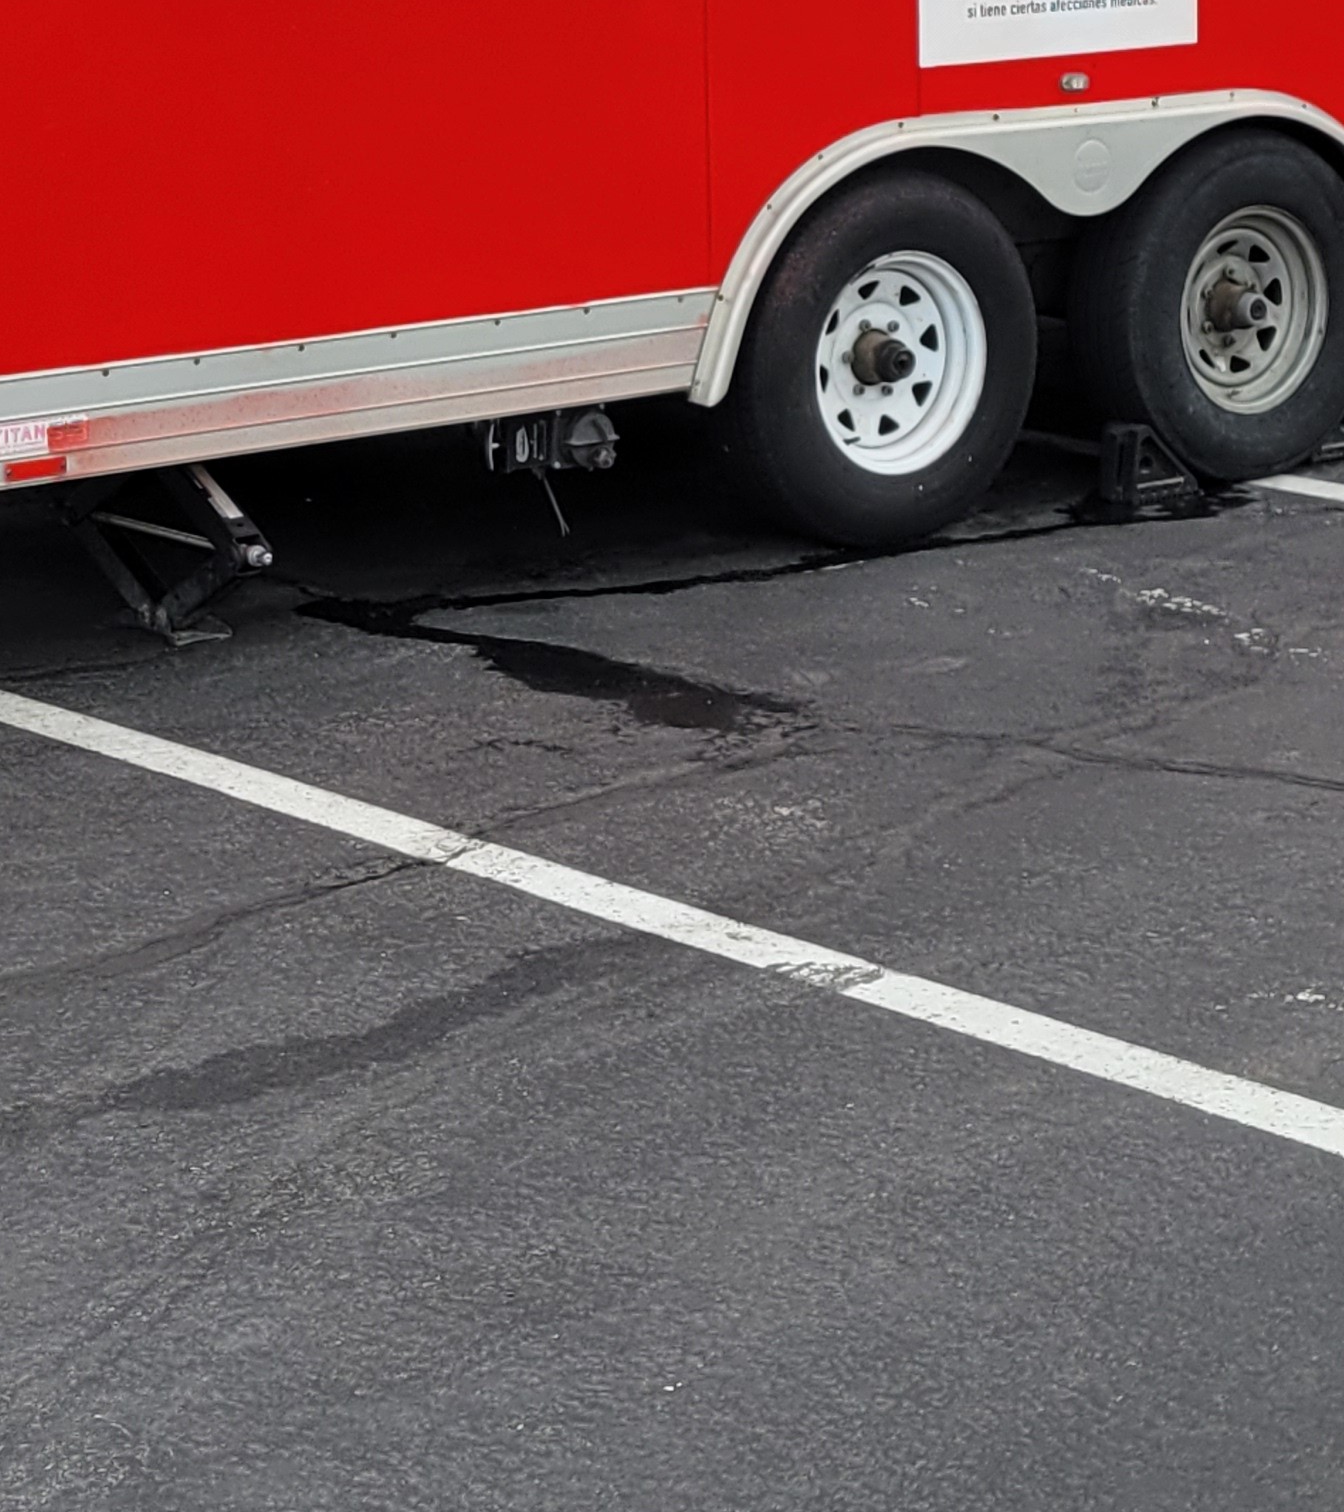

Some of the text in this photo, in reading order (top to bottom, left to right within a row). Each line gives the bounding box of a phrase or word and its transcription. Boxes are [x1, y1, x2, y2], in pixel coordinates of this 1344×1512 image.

[967, 2, 977, 19] si
[980, 2, 1007, 18] tiene
[1010, 0, 1047, 16] ciertas
